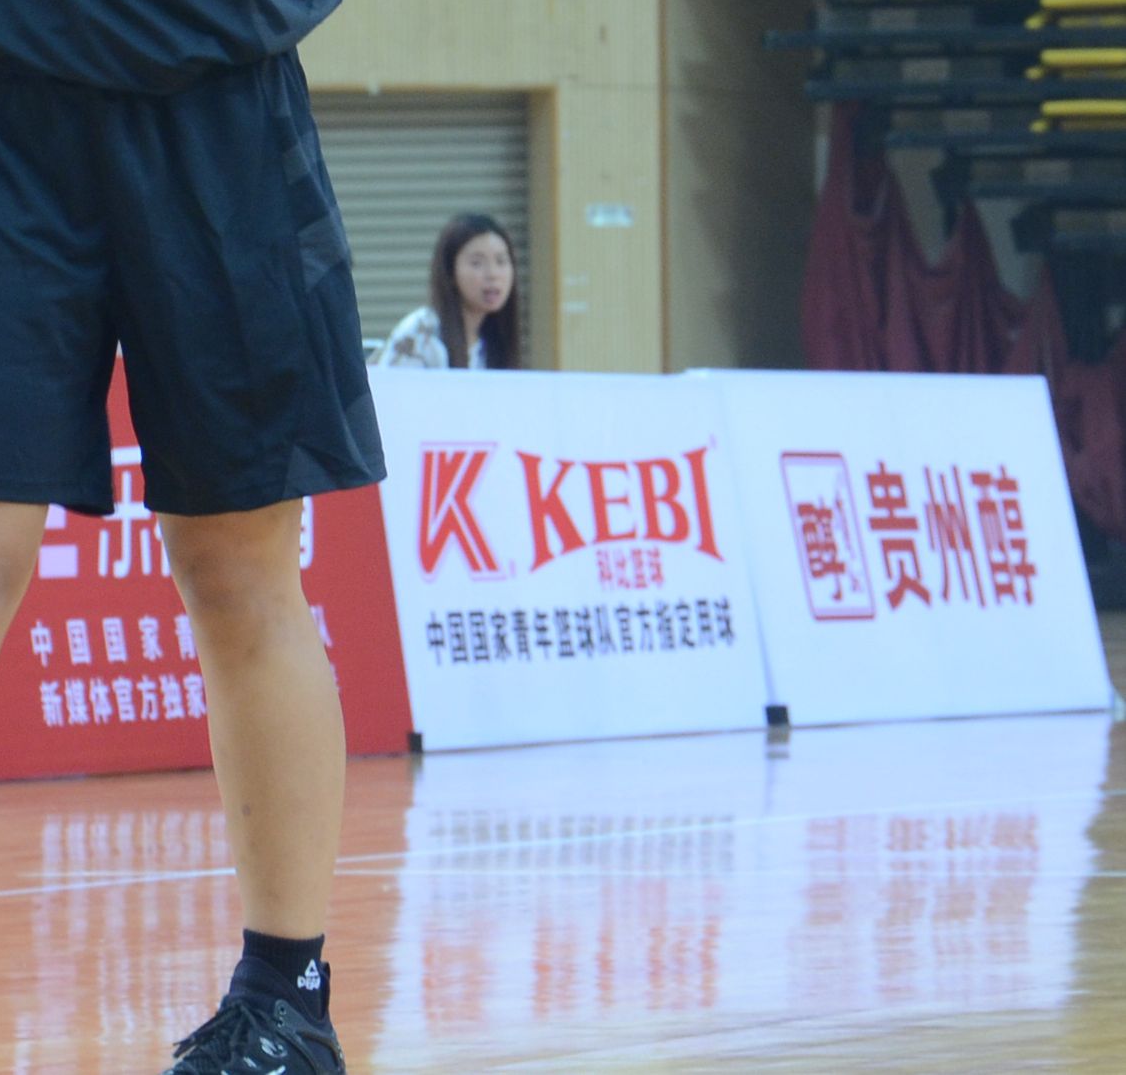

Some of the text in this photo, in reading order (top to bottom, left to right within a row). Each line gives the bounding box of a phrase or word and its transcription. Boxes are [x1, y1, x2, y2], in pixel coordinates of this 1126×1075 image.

[514, 445, 725, 573] KEBI
[866, 460, 1038, 611] 贵州醇
